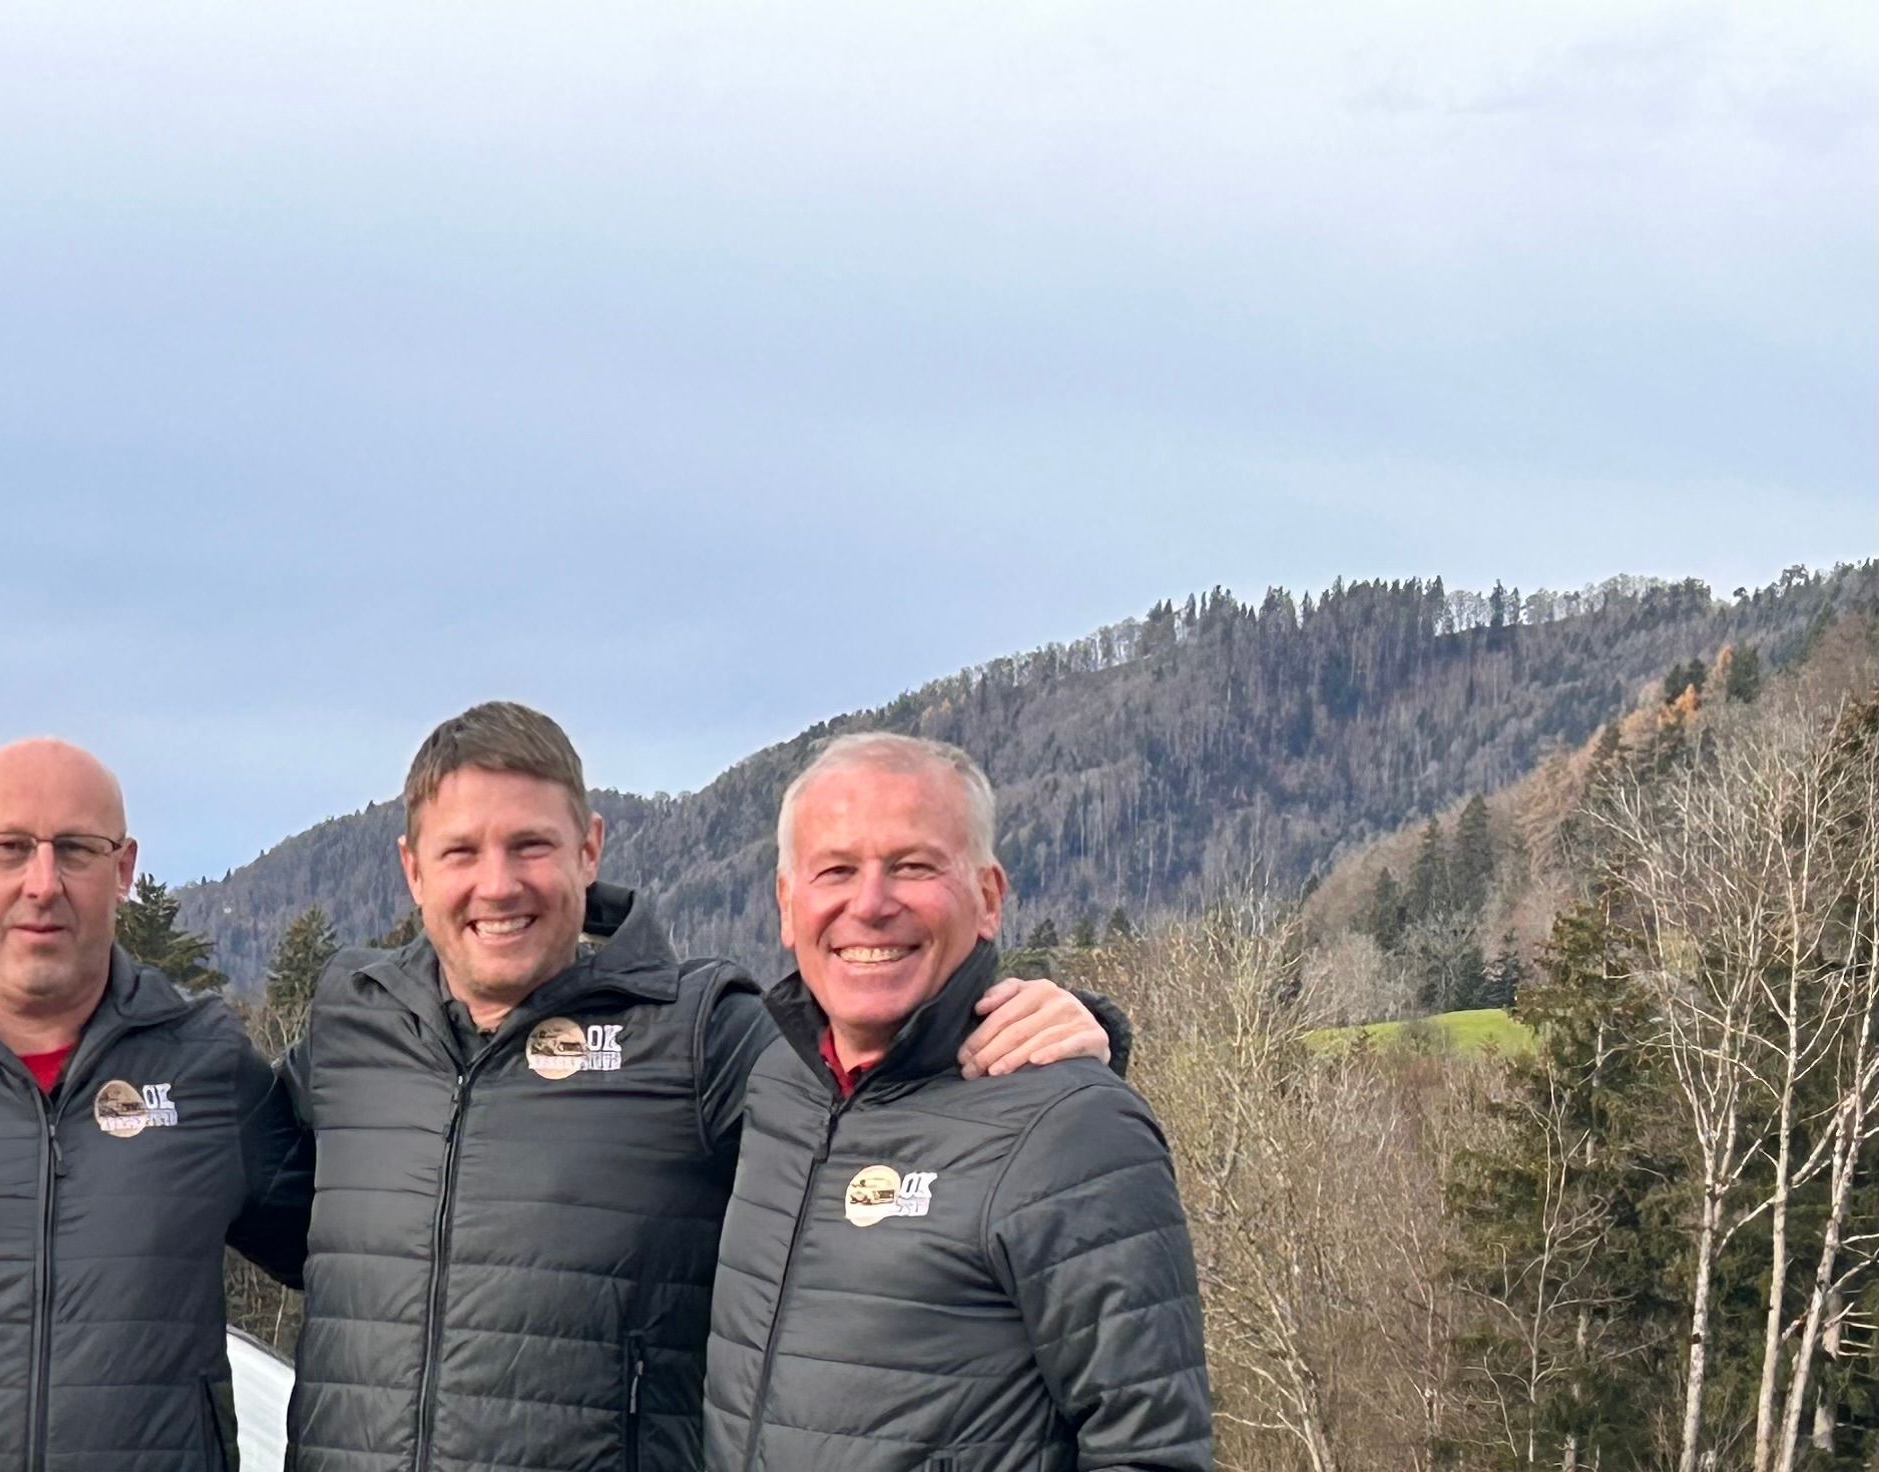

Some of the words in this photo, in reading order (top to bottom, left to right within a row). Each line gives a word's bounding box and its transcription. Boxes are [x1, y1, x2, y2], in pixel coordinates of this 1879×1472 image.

[587, 1024, 623, 1052] OK
[142, 1083, 175, 1110] OK
[901, 1172, 938, 1198] OK
